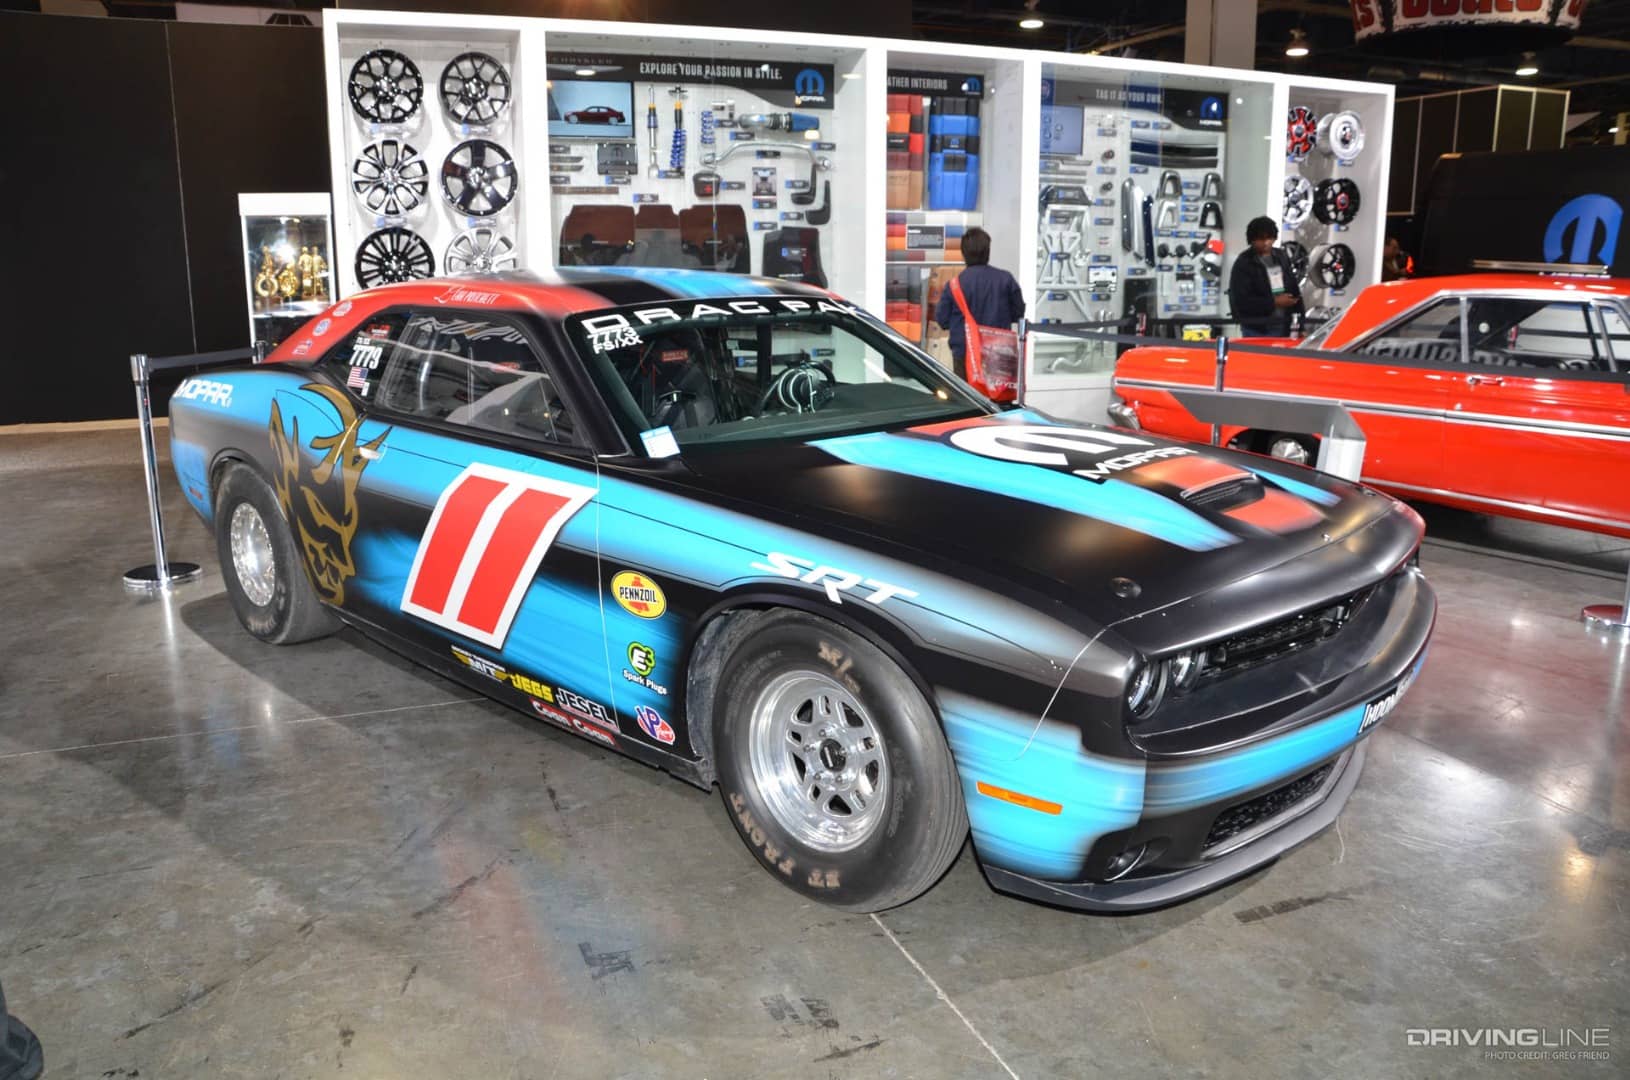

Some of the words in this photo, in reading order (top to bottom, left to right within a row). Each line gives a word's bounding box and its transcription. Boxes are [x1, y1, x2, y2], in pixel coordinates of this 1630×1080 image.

[640, 62, 677, 75] EXPLORE
[679, 63, 703, 75] YOUR
[704, 65, 742, 79] PASSION
[744, 67, 753, 78] IN
[581, 300, 770, 334] DRAG
[779, 300, 869, 318] PAK
[349, 344, 383, 369] 7779
[1072, 446, 1199, 480] MOPAR
[750, 551, 921, 605] SRT
[619, 586, 657, 603] PENNZOIL
[511, 674, 554, 704] JEGS
[623, 669, 646, 686] Spark
[646, 678, 668, 696] Plugs
[555, 687, 617, 725] JESEL
